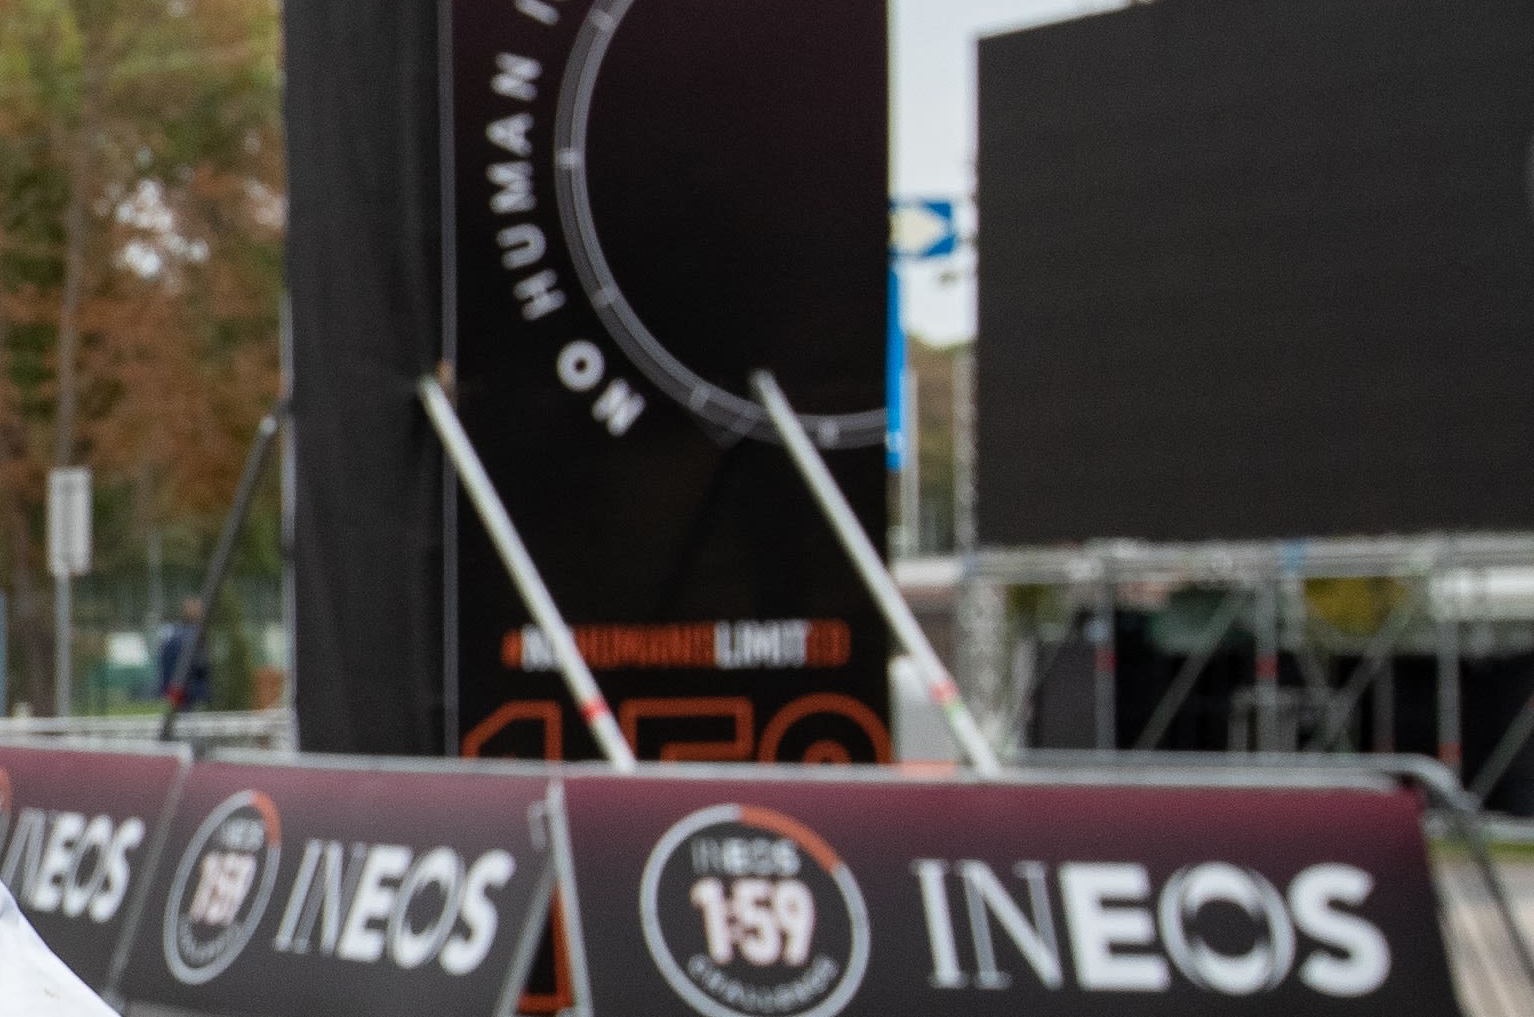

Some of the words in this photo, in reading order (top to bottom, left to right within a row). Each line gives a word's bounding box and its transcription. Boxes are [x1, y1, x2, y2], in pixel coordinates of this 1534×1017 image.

[486, 50, 568, 322] HUMAN
[556, 338, 648, 437] NO
[0, 806, 146, 924] INEOS
[273, 837, 517, 977] INEOS
[689, 836, 802, 876] INEOS
[910, 857, 1393, 999] INEOS
